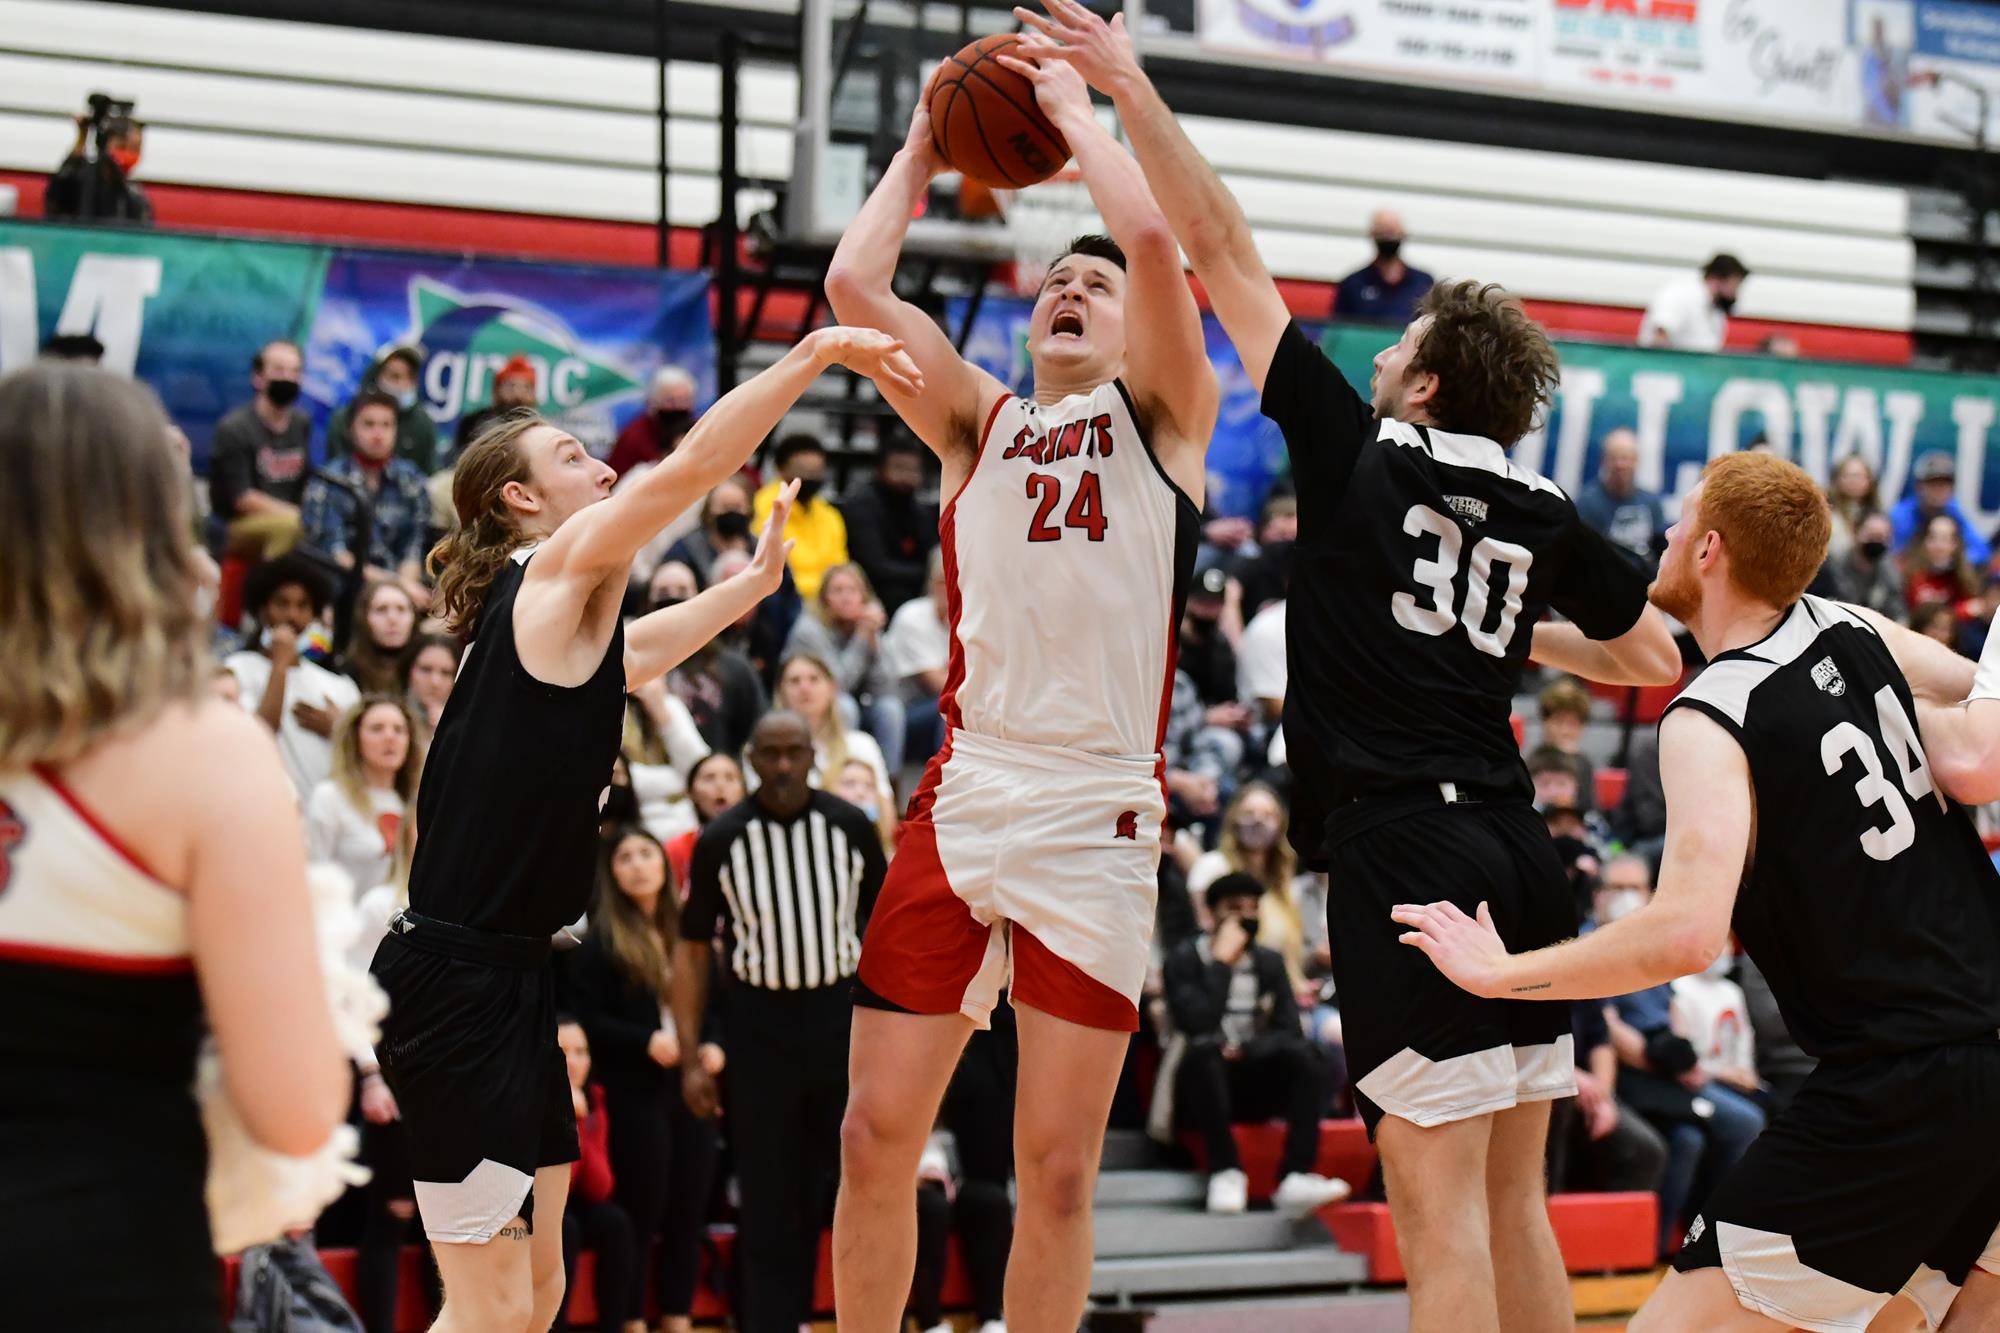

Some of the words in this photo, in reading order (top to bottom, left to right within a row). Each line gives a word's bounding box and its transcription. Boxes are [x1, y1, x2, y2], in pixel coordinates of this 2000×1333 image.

[1002, 413, 1114, 466] SAINTS
[1026, 470, 1108, 542] 24
[1391, 503, 1534, 658] 30
[1821, 684, 1948, 861] 34
